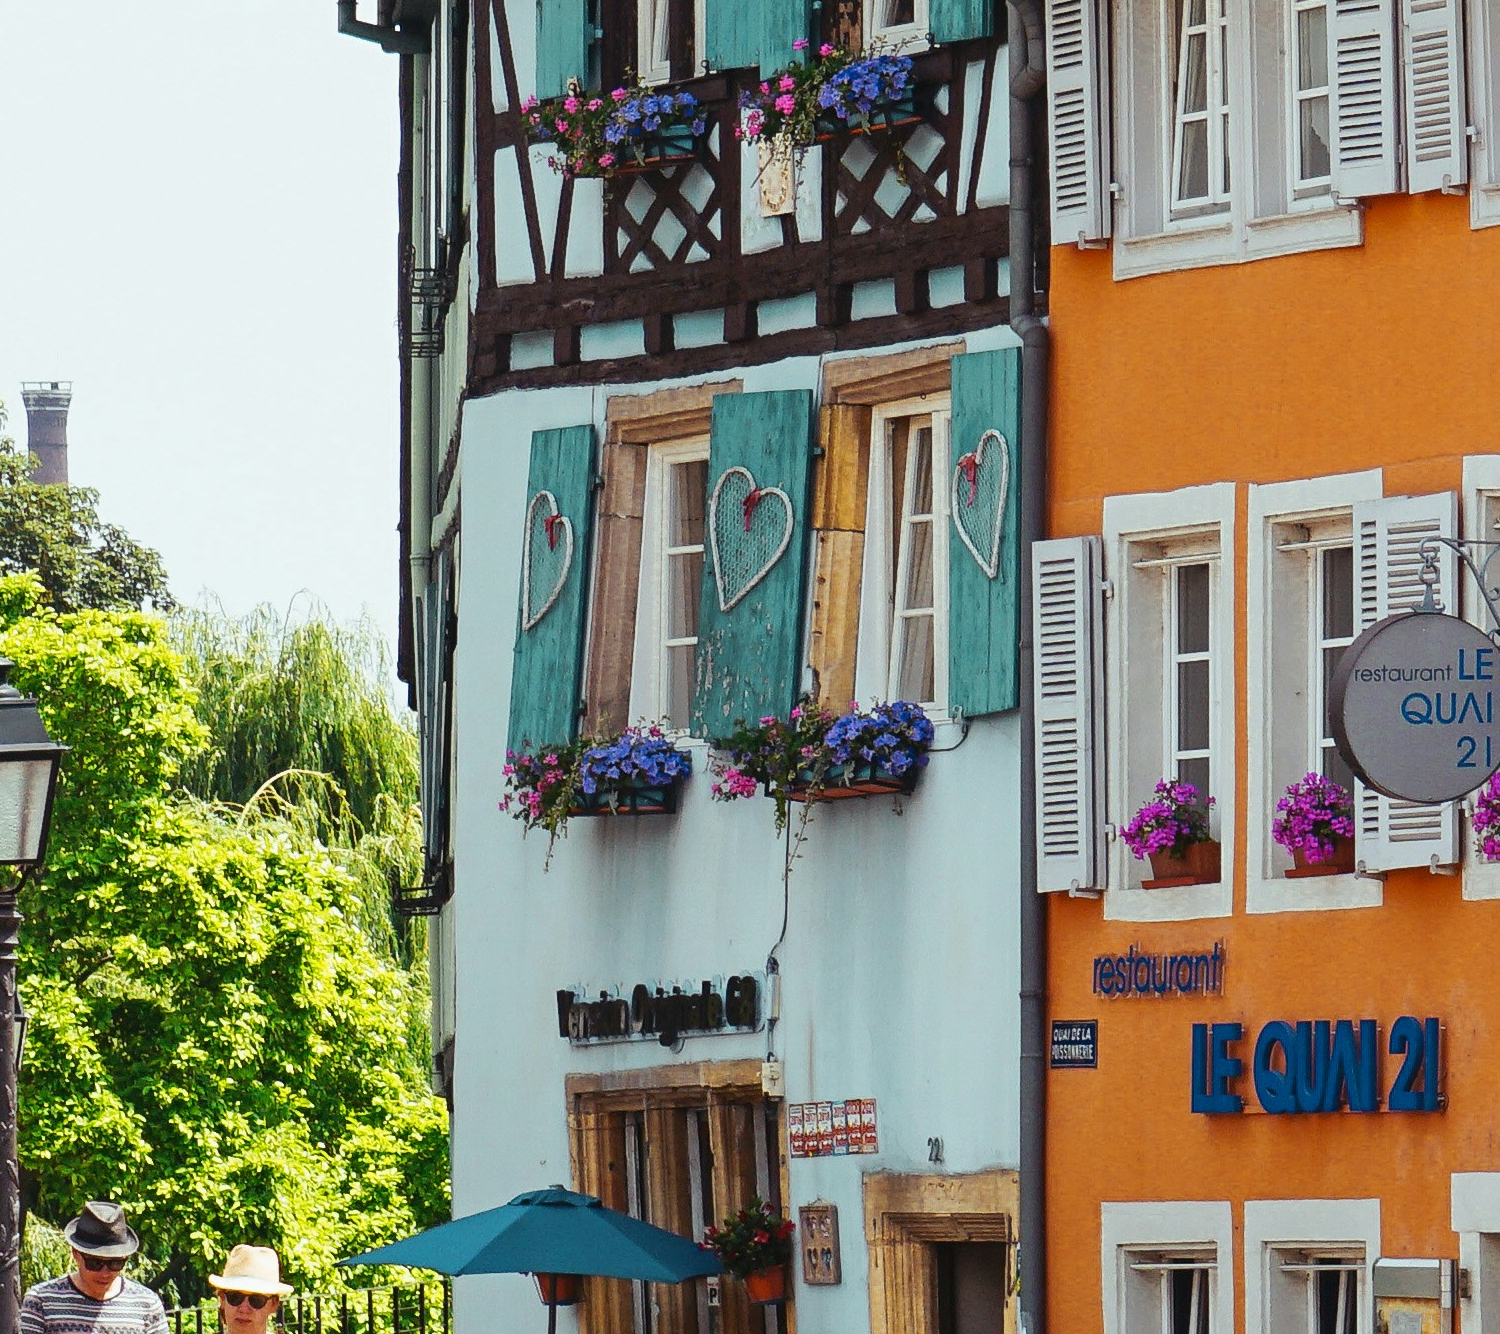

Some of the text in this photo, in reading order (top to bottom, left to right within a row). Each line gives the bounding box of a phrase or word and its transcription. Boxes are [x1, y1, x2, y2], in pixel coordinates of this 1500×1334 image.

[1354, 648, 1493, 682] restaurant LE
[1401, 691, 1493, 725] QUAI
[1456, 736, 1492, 768] 21
[1092, 941, 1222, 995] restaurant
[1053, 1028, 1070, 1041] QUAI
[1081, 1027, 1092, 1041] LA
[1191, 1015, 1441, 1114] LE QUAI 21
[927, 1136, 944, 1164] 22
